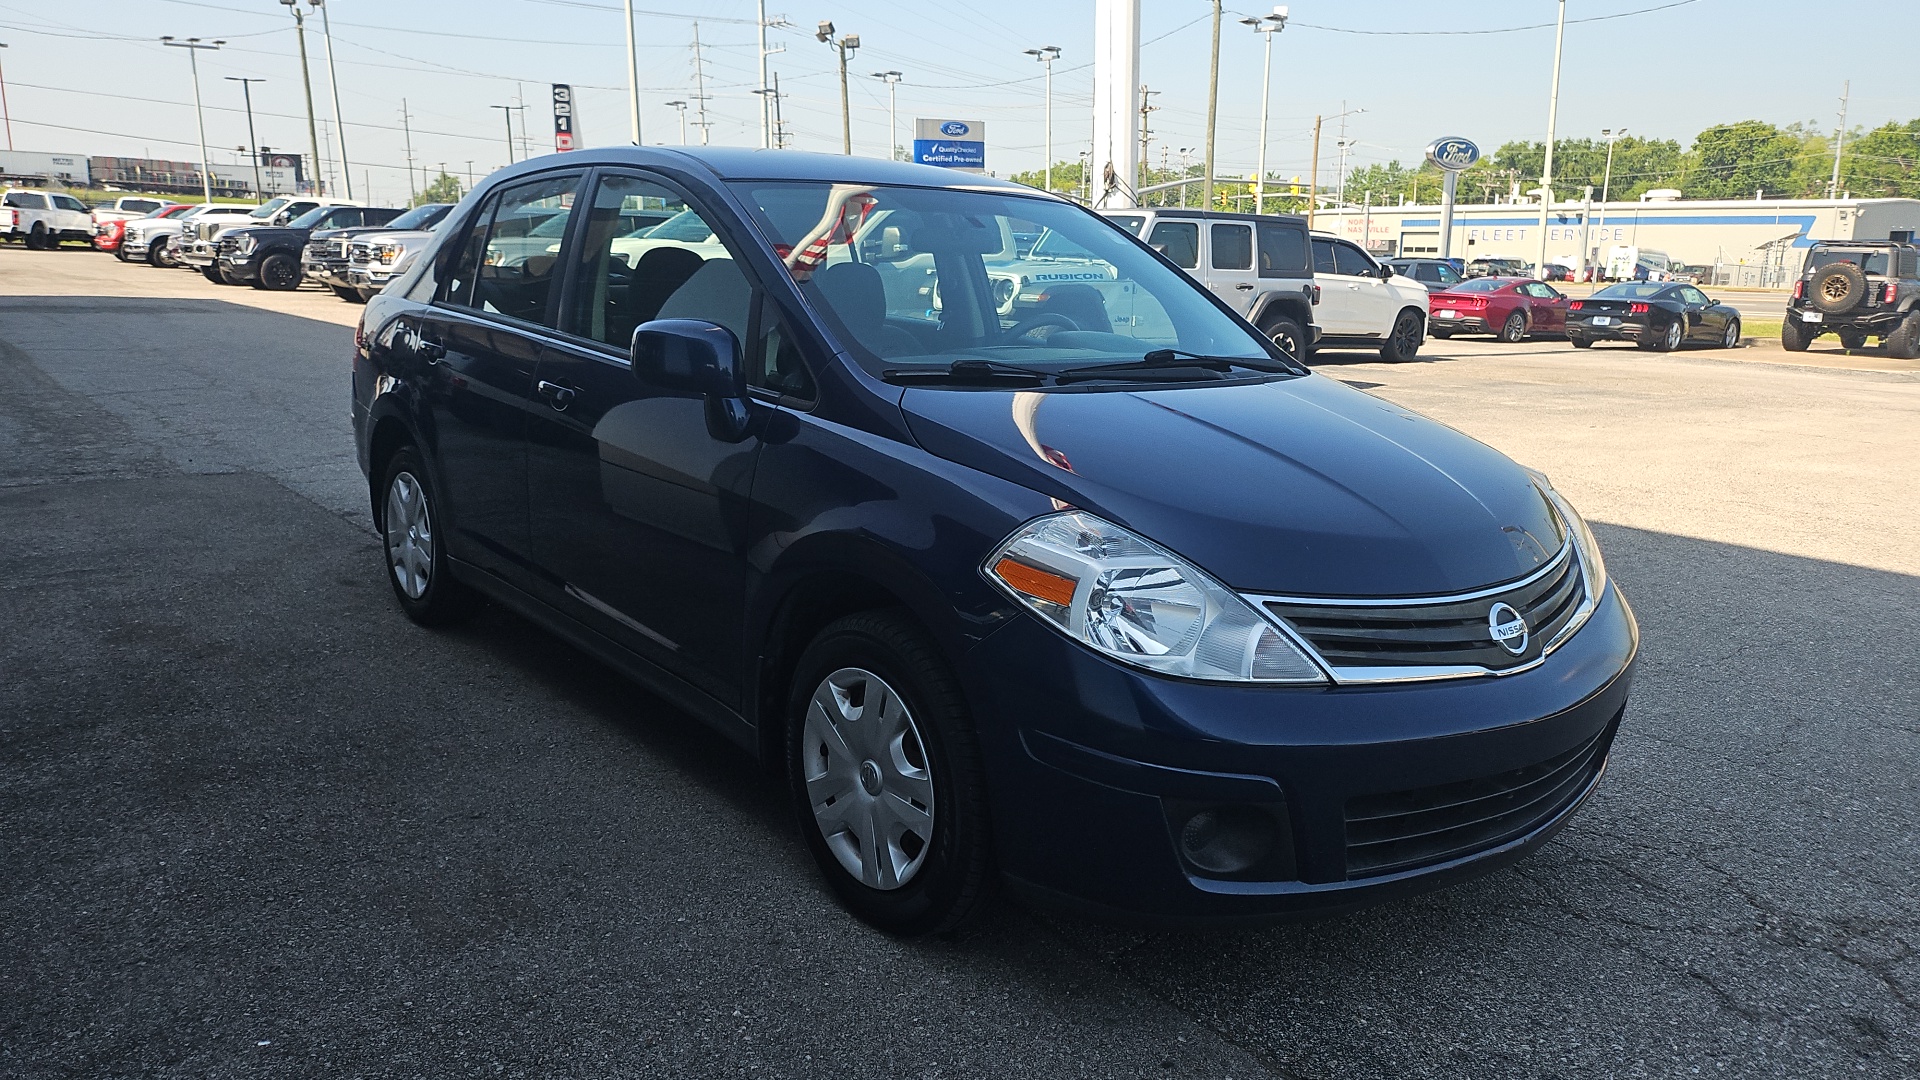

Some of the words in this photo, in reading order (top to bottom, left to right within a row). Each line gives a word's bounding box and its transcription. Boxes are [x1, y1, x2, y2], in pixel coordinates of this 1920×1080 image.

[947, 124, 965, 134] Ford
[922, 154, 953, 163] Certified
[953, 155, 983, 163] Pre-owned
[1442, 142, 1473, 165] Ford
[1471, 229, 1527, 241] FLEET
[1550, 229, 1624, 241] ERICE
[1035, 273, 1104, 281] RUBICON
